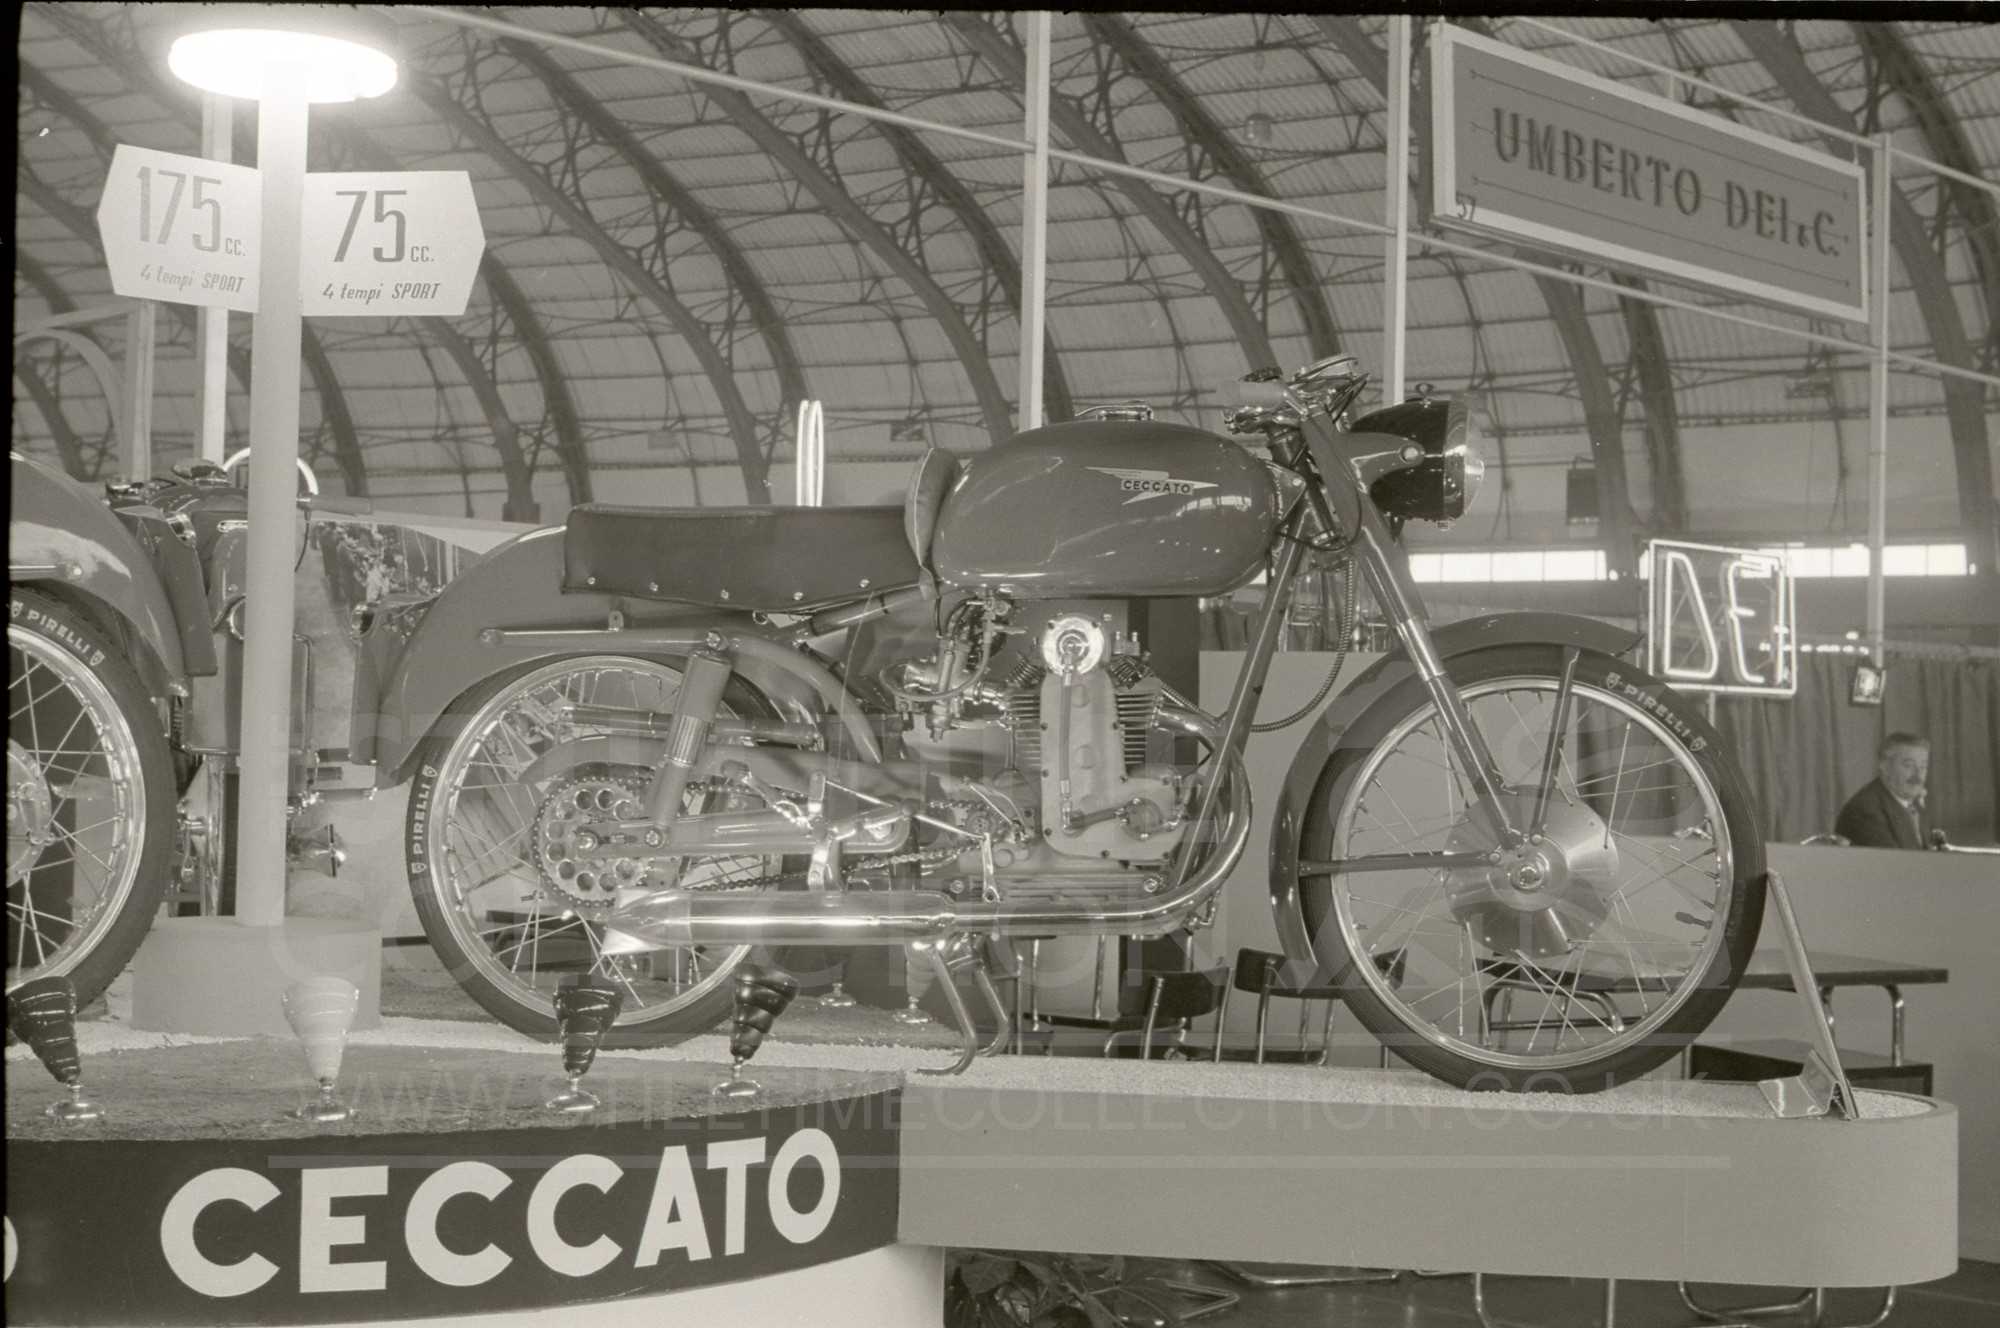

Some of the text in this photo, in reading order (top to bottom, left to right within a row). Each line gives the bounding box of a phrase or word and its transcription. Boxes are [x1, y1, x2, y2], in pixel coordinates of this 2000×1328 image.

[1493, 107, 1701, 216] UMBERTO
[1725, 180, 1791, 244] DEI
[136, 166, 222, 252] 175
[333, 190, 407, 263] 75
[140, 264, 246, 294] 4 tempi SPORT
[322, 282, 441, 305] 4 tempi SPORT
[1122, 479, 1191, 494] CECCATO
[27, 608, 91, 654] PIRELLI
[1624, 683, 1691, 737] PIRELLI
[413, 783, 430, 855] PIRELLI
[160, 1127, 841, 1298] CECCATO
